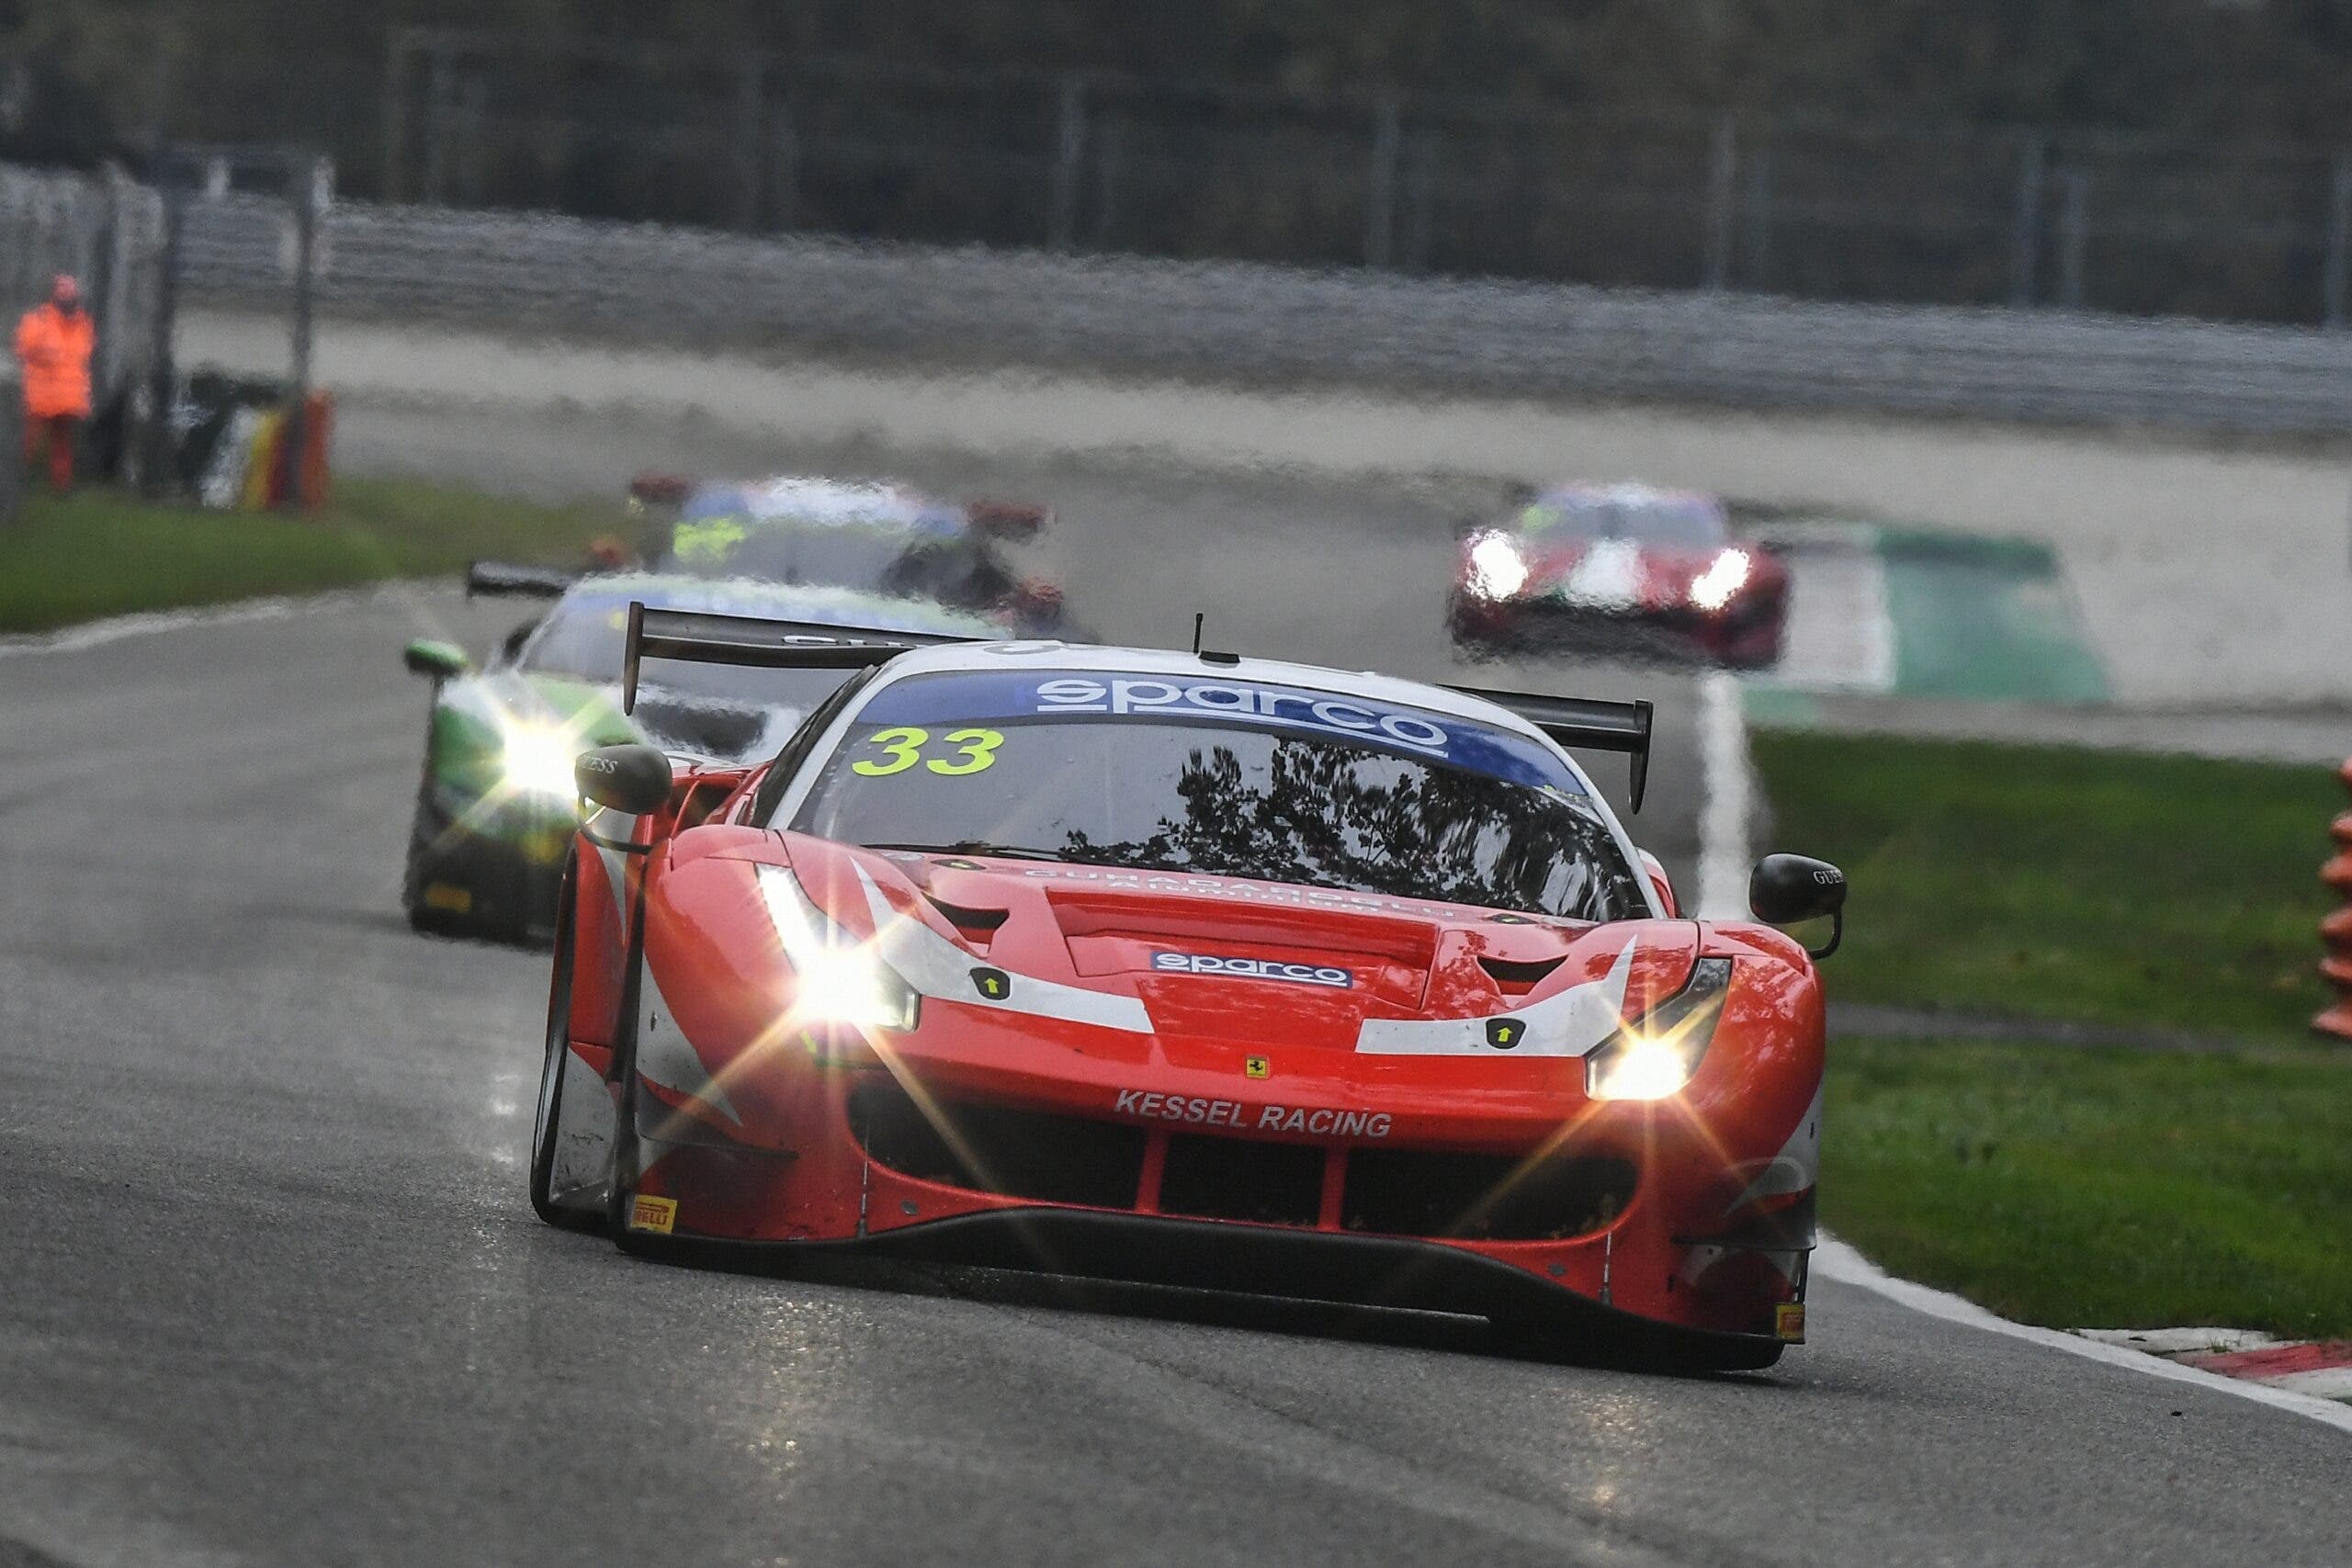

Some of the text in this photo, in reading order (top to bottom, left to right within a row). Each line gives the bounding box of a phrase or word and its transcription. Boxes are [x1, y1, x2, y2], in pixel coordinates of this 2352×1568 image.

[1036, 679, 1448, 749] sparco
[852, 727, 1004, 776] 33
[1156, 953, 1348, 984] sparco
[1113, 1089, 1393, 1138] KESSEL RACING
